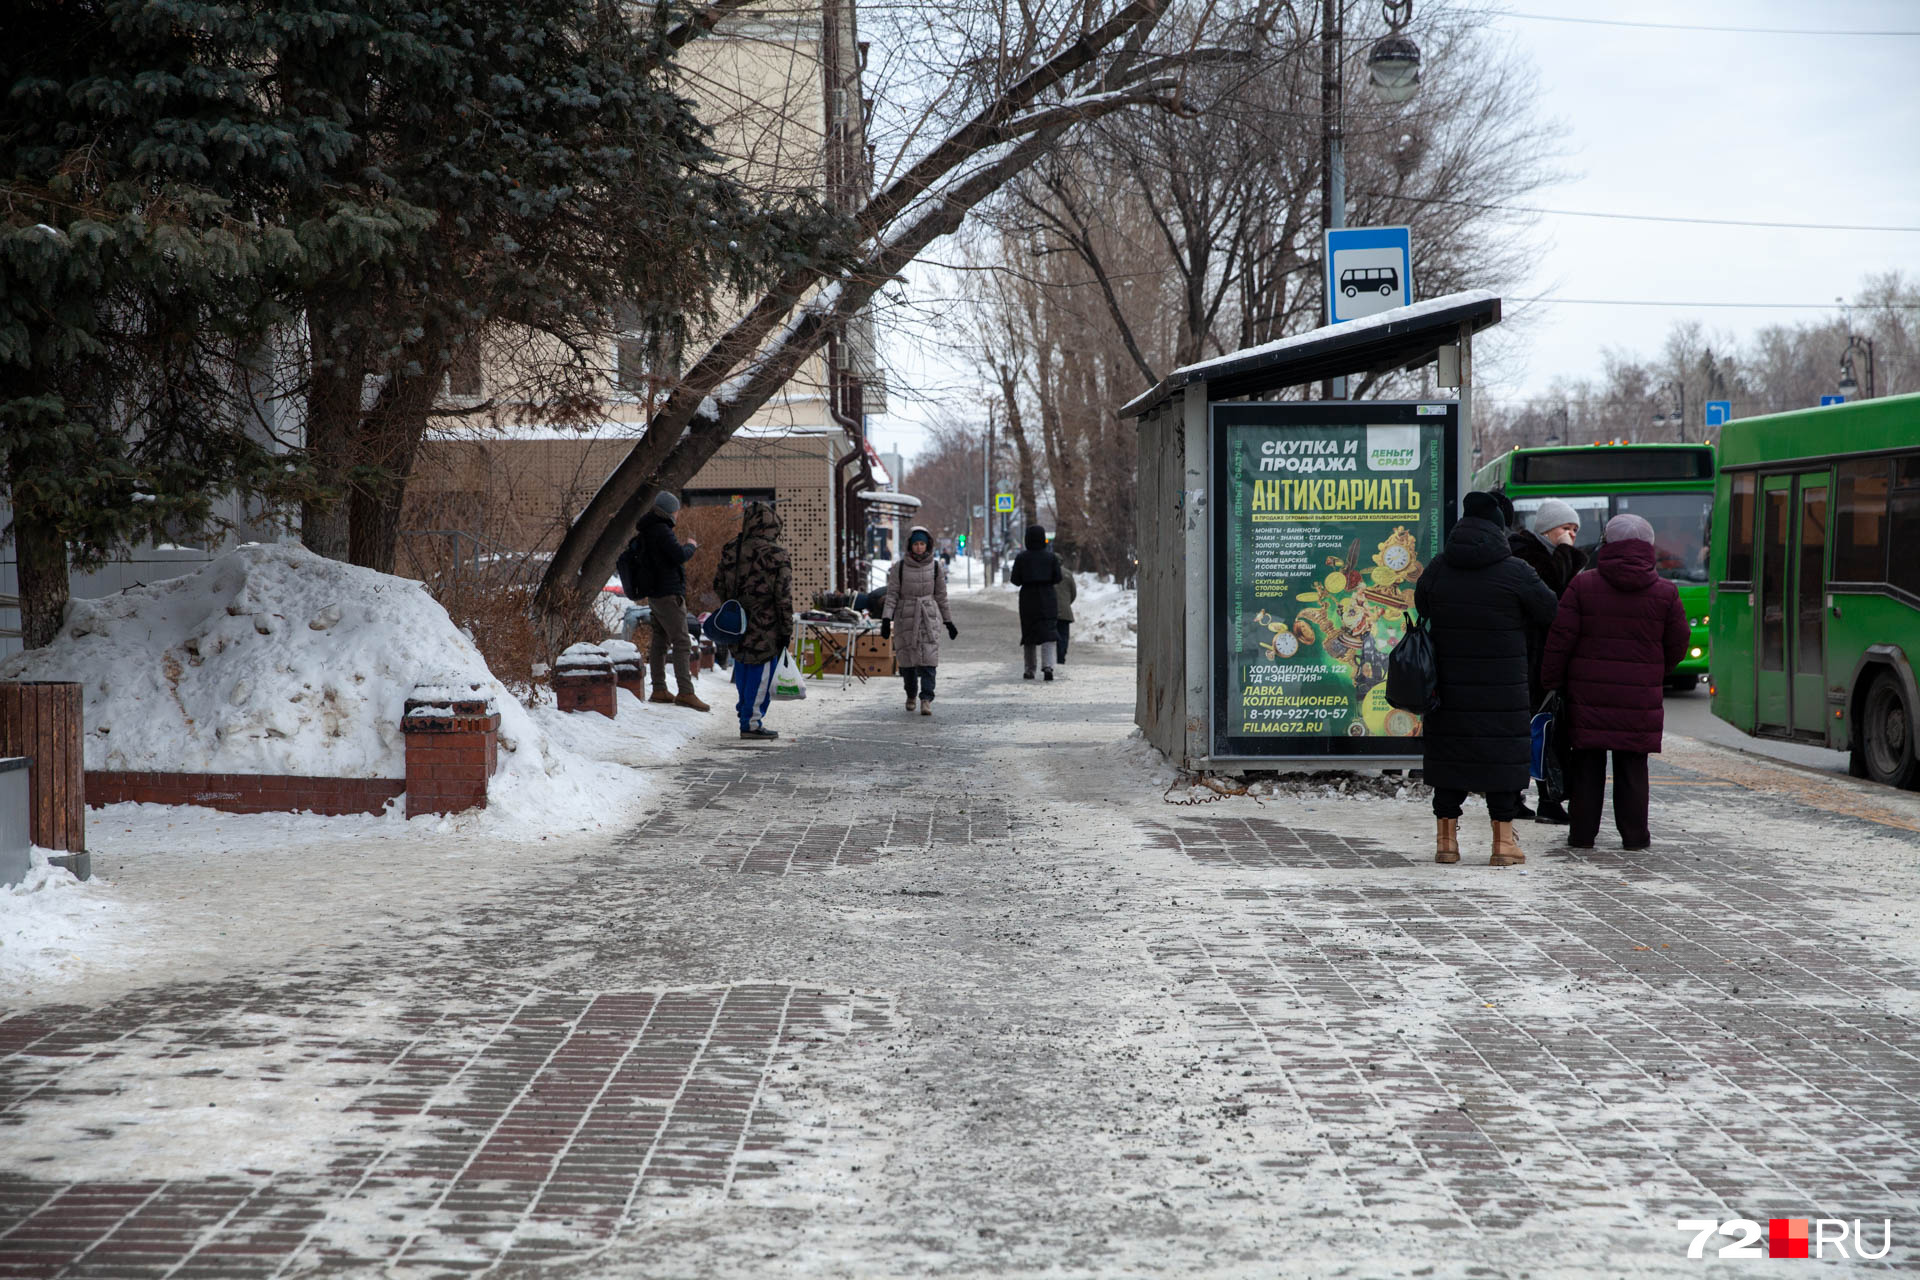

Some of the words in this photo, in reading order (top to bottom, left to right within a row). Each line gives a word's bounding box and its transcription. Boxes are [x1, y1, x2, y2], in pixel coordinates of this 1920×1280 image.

[1261, 440, 1339, 455] СКУПКА
[1343, 440, 1358, 455] И
[1371, 449, 1414, 458] ДЕНЬГИ
[1235, 451, 1243, 479] СРАЗУ
[1259, 457, 1357, 473] ПРОДАЖА
[1377, 458, 1412, 466] СРАЗУ
[1235, 481, 1243, 517] ДЕНЬГИ
[1252, 479, 1421, 511] АНТИКВАРИАТЪ
[1235, 532, 1243, 585] ПОКУПАЕМ
[1235, 601, 1243, 653] ВЫКУПАЕМ
[1249, 665, 1329, 674] ХОЛОДИЛЬНАЯ,
[1331, 665, 1347, 673] 122
[1249, 674, 1263, 684] ТД
[1264, 674, 1322, 683] «ЭНЕРГИЯ»
[1243, 686, 1284, 696] ЛАВКА
[1242, 696, 1349, 707] КОЛЛЕКЦИОНЕРА
[1250, 709, 1348, 720] 8-919-927-10-57
[1242, 722, 1323, 733] FILMAG72.RU
